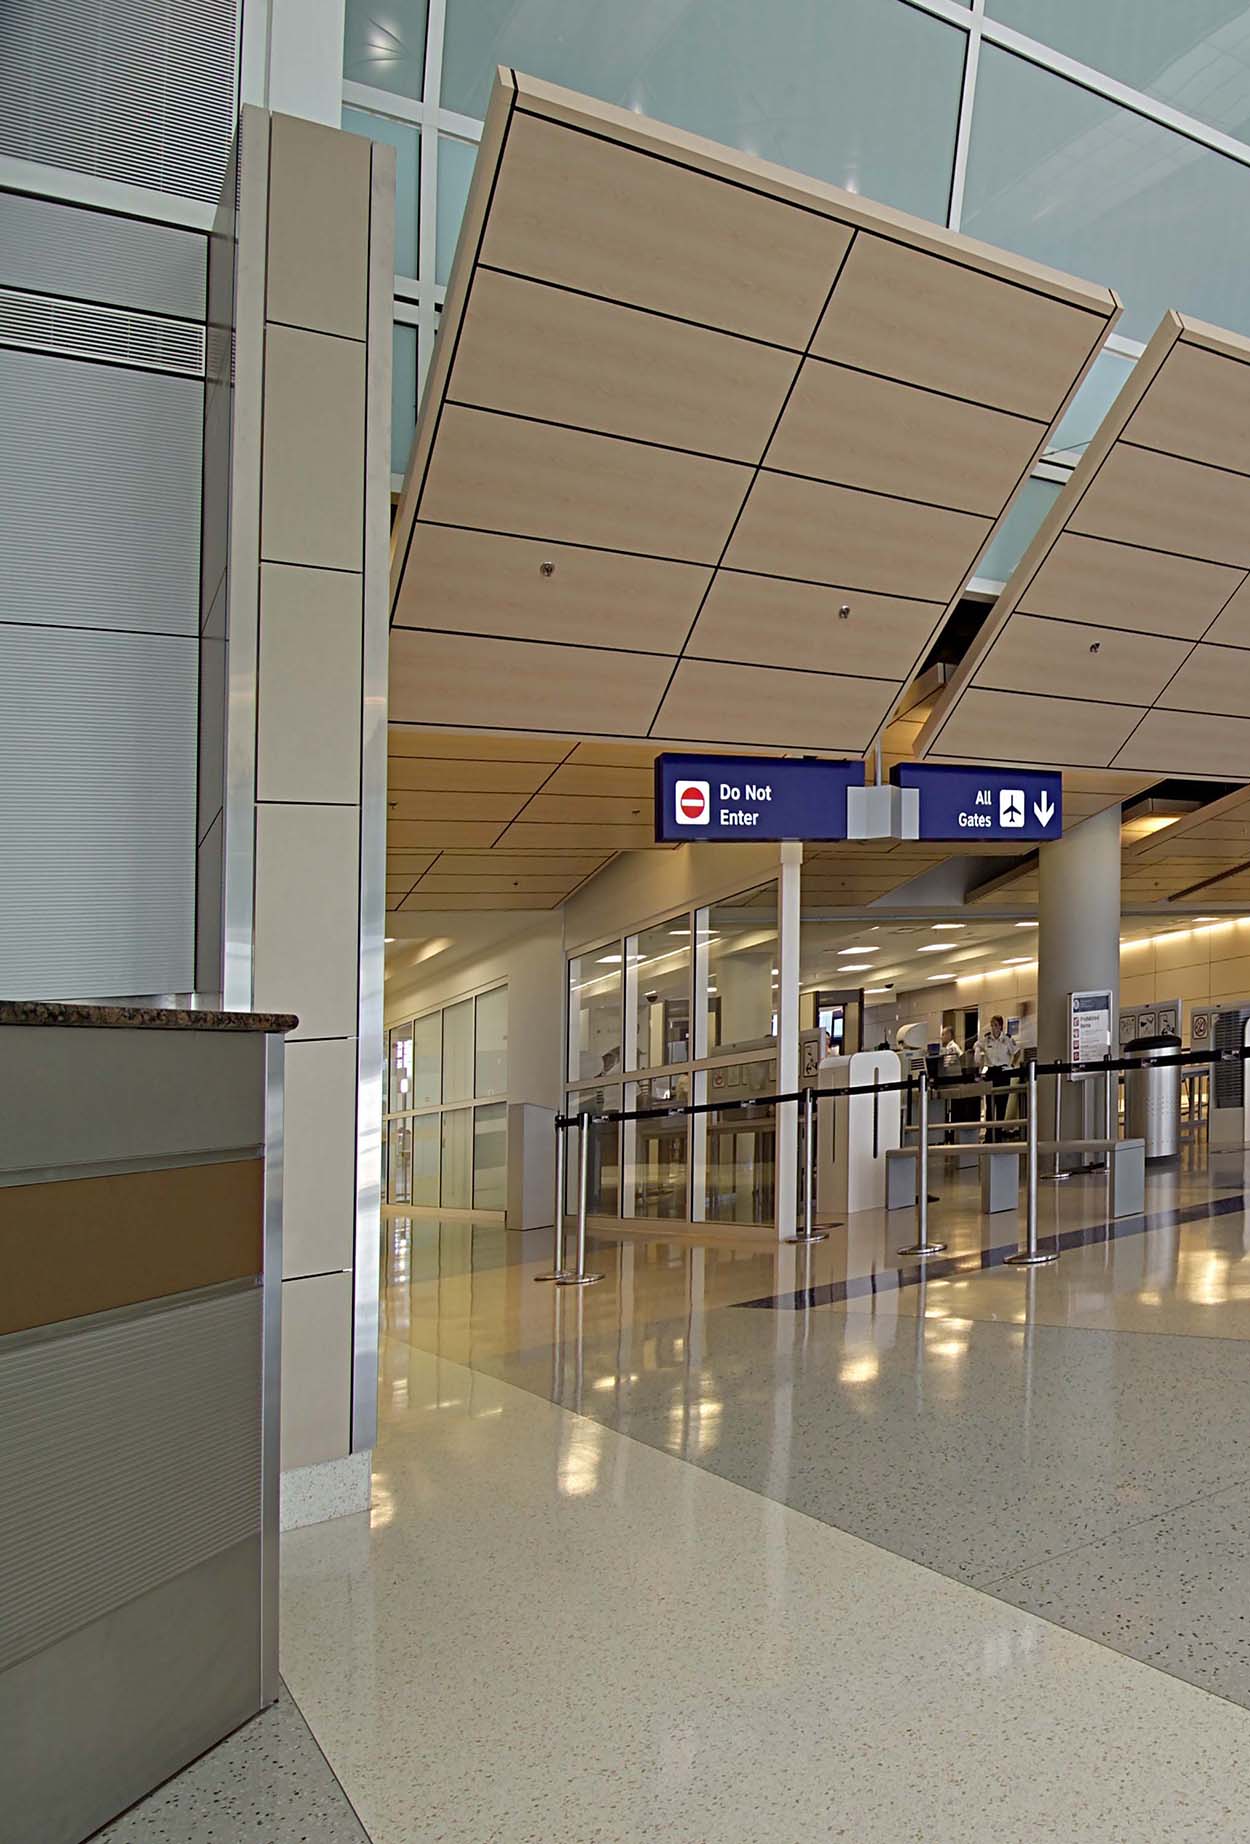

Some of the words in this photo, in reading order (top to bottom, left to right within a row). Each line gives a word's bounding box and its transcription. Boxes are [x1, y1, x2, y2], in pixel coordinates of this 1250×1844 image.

[719, 783, 741, 801] Do
[745, 784, 772, 802] Not
[975, 789, 992, 806] All
[720, 809, 759, 826] Enter
[958, 812, 992, 828] Gates
